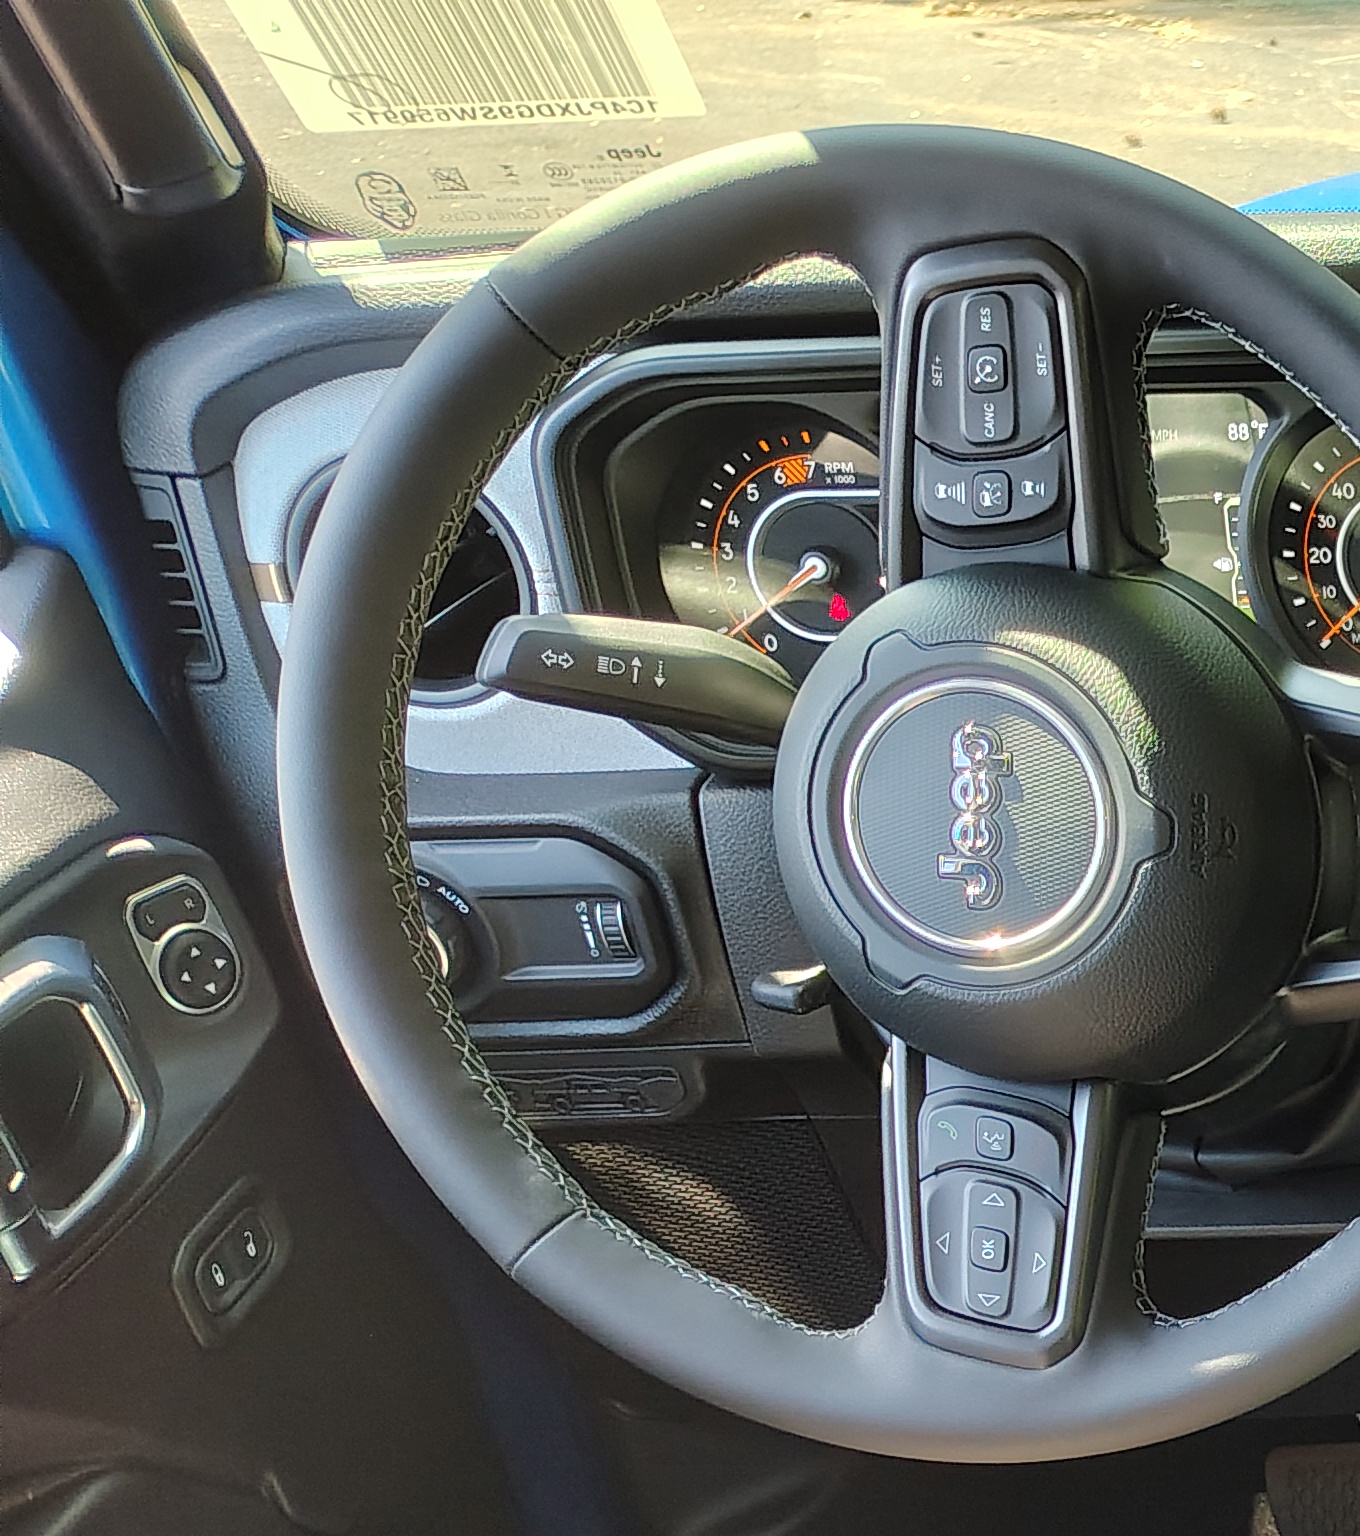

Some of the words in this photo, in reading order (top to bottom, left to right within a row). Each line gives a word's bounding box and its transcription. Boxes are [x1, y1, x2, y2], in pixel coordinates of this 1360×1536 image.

[980, 306, 992, 333] RES
[984, 401, 996, 438] CANC
[1150, 429, 1179, 442] MPH
[774, 466, 787, 485] 6
[803, 460, 816, 479] 7
[824, 461, 855, 474] RPM
[833, 475, 856, 485] 1000
[746, 484, 760, 501] 5
[1213, 491, 1223, 505] F
[1331, 482, 1355, 501] 40
[727, 510, 741, 528] 4
[1317, 514, 1337, 530] 30
[721, 543, 734, 561] 3
[1309, 547, 1332, 565] 20
[725, 577, 737, 594] 2
[1320, 585, 1337, 600] 10
[763, 634, 778, 652] 0
[936, 719, 1013, 910] Jeep
[184, 898, 196, 910] R
[436, 886, 470, 914] AUTO
[145, 914, 156, 925] L
[982, 1239, 995, 1260] OK
